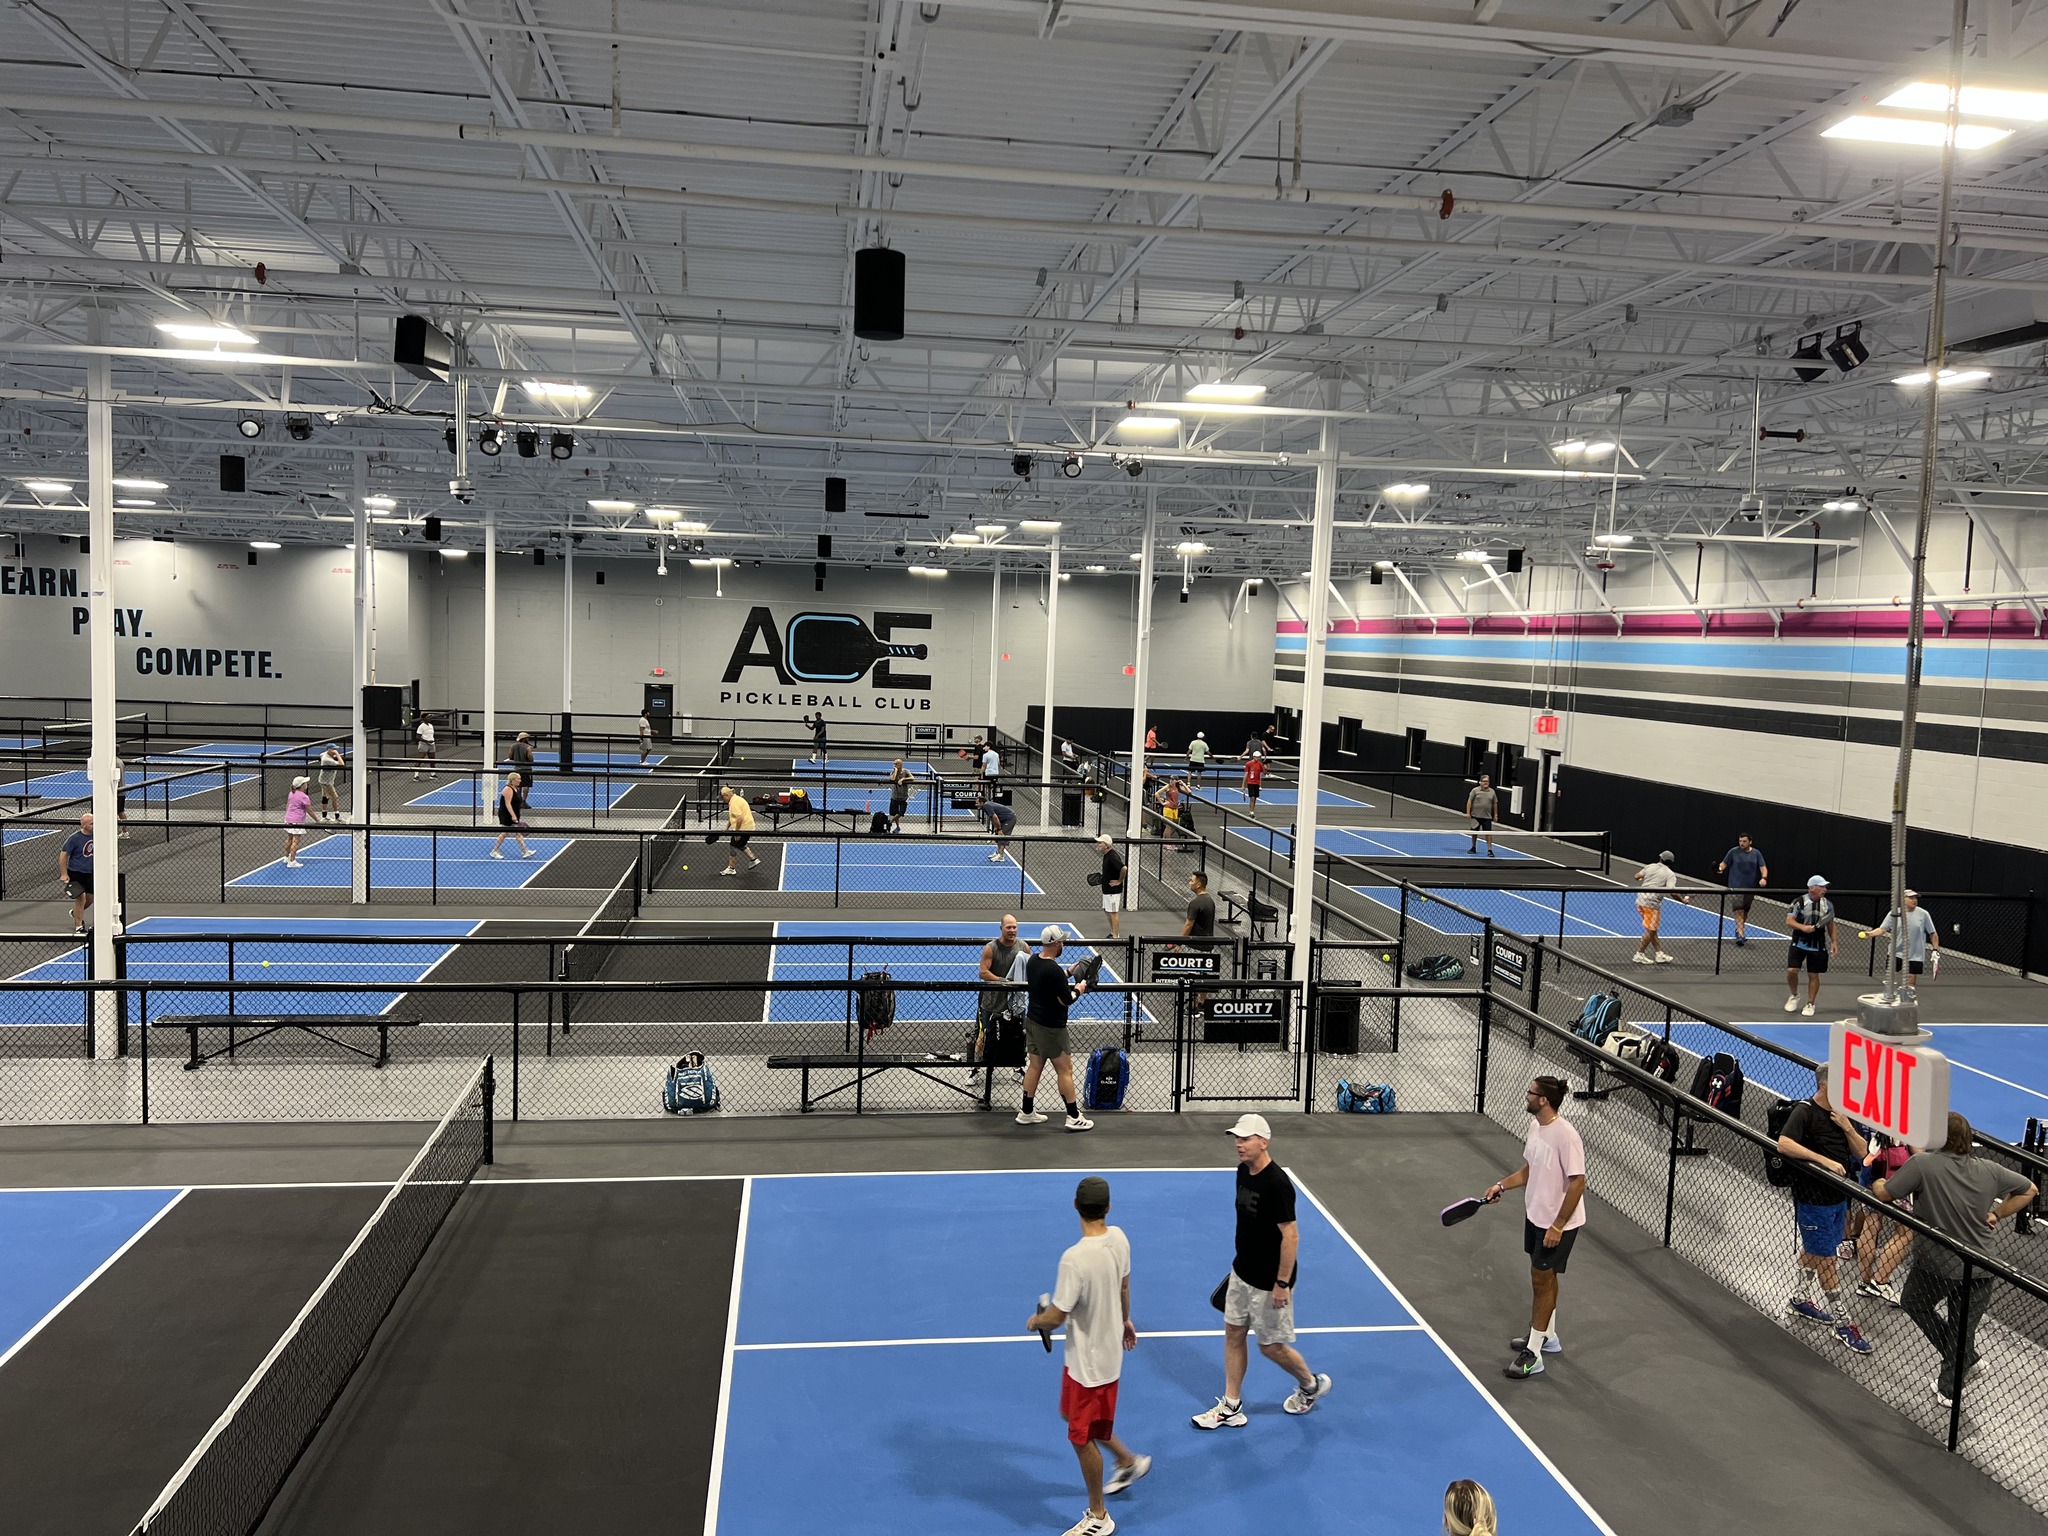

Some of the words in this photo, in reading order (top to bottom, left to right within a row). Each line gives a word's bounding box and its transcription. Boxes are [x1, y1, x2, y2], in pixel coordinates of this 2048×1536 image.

[1, 566, 89, 597] EARN.
[72, 607, 152, 637] PAY.
[136, 647, 283, 679] COMPETE.
[720, 691, 862, 708] PICKLEBALL
[875, 697, 932, 710] CLUB
[1537, 716, 1559, 733] EXIT
[1160, 957, 1204, 968] COURT
[1205, 958, 1213, 968] 8
[1495, 945, 1516, 962] COURT
[1213, 1002, 1263, 1014] COURT
[1264, 1003, 1273, 1014] 7
[1842, 1030, 1917, 1136] EXIT
